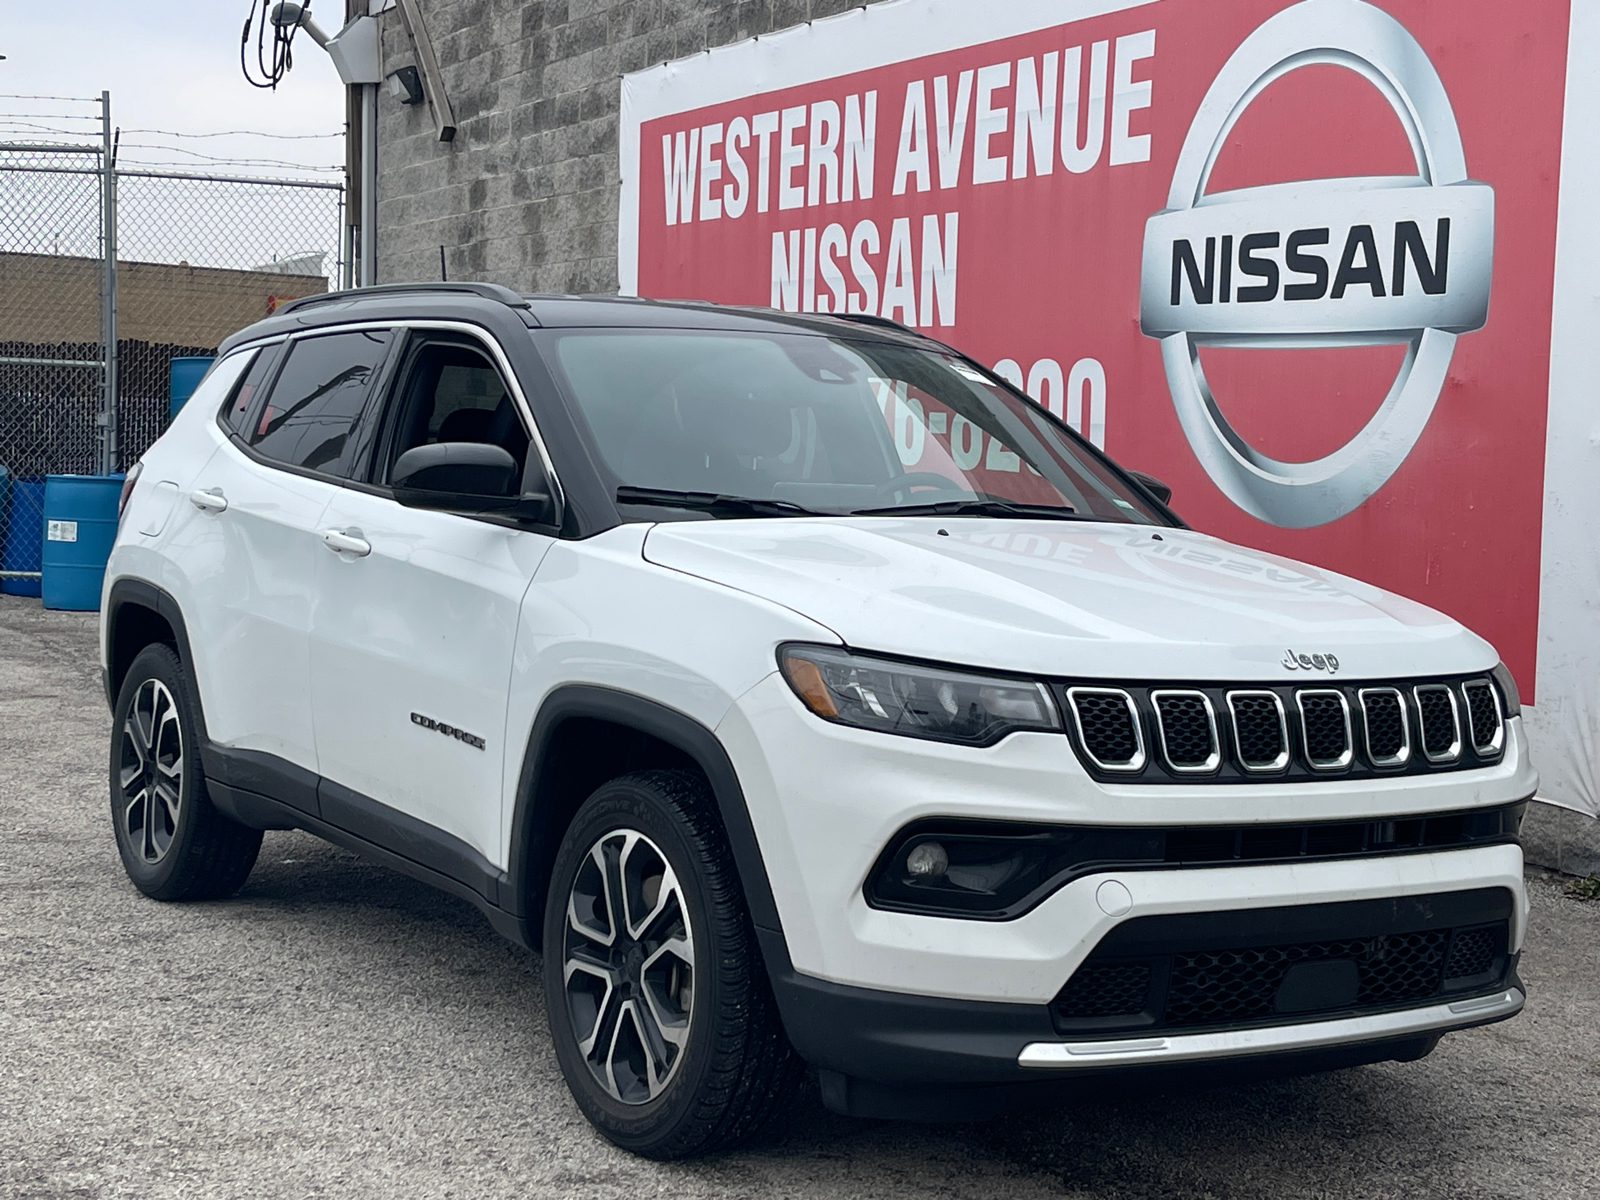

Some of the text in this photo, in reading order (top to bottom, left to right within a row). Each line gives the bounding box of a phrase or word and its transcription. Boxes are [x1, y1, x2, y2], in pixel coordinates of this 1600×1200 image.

[662, 28, 1157, 226] WESTERN AVENUE
[770, 211, 959, 327] NISSAN
[1170, 217, 1451, 306] NISSAN
[1280, 648, 1340, 674] Jeep
[410, 711, 486, 751] COMPASS
